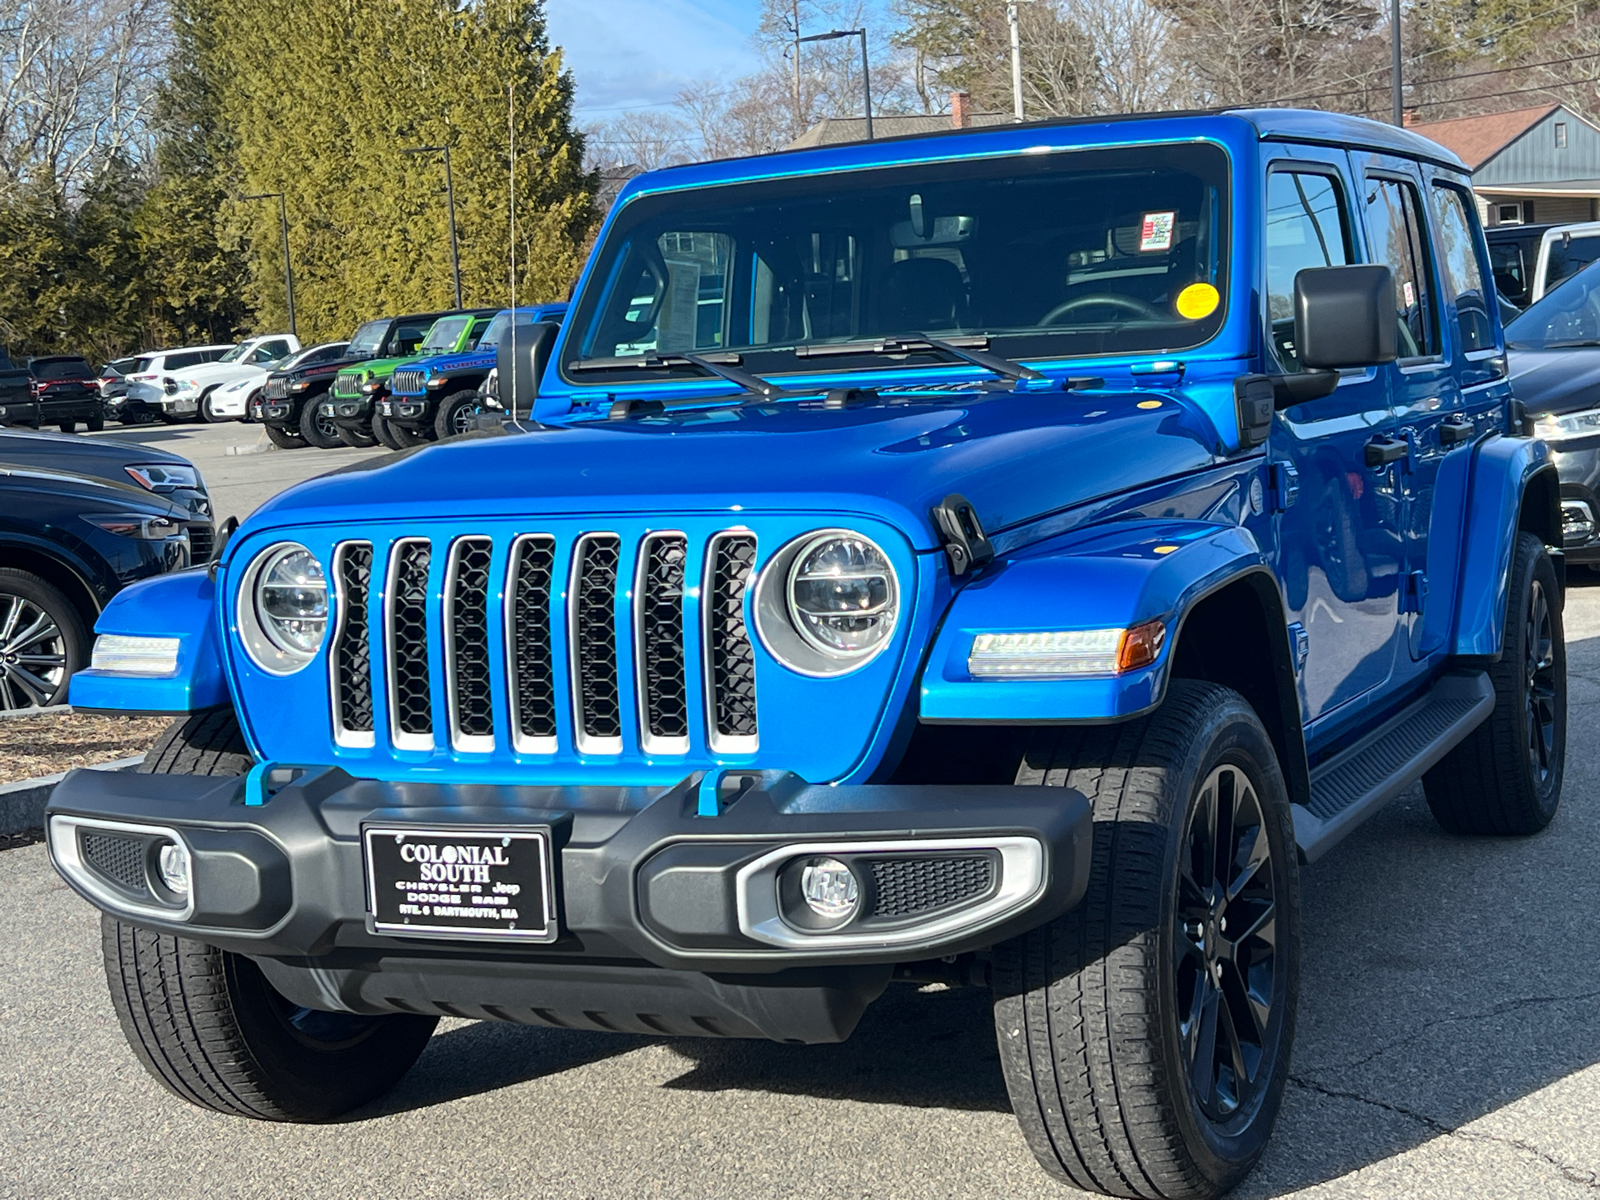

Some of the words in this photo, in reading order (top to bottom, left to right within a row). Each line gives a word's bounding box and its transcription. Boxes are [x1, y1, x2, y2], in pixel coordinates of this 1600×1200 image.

[400, 844, 509, 865] COLONIAL
[420, 863, 490, 883] SOUTH
[395, 881, 483, 893] CHRYSLER
[492, 881, 520, 896] Jeep
[406, 892, 462, 904] DODGE
[471, 896, 509, 905] RAM
[501, 908, 518, 919] MA
